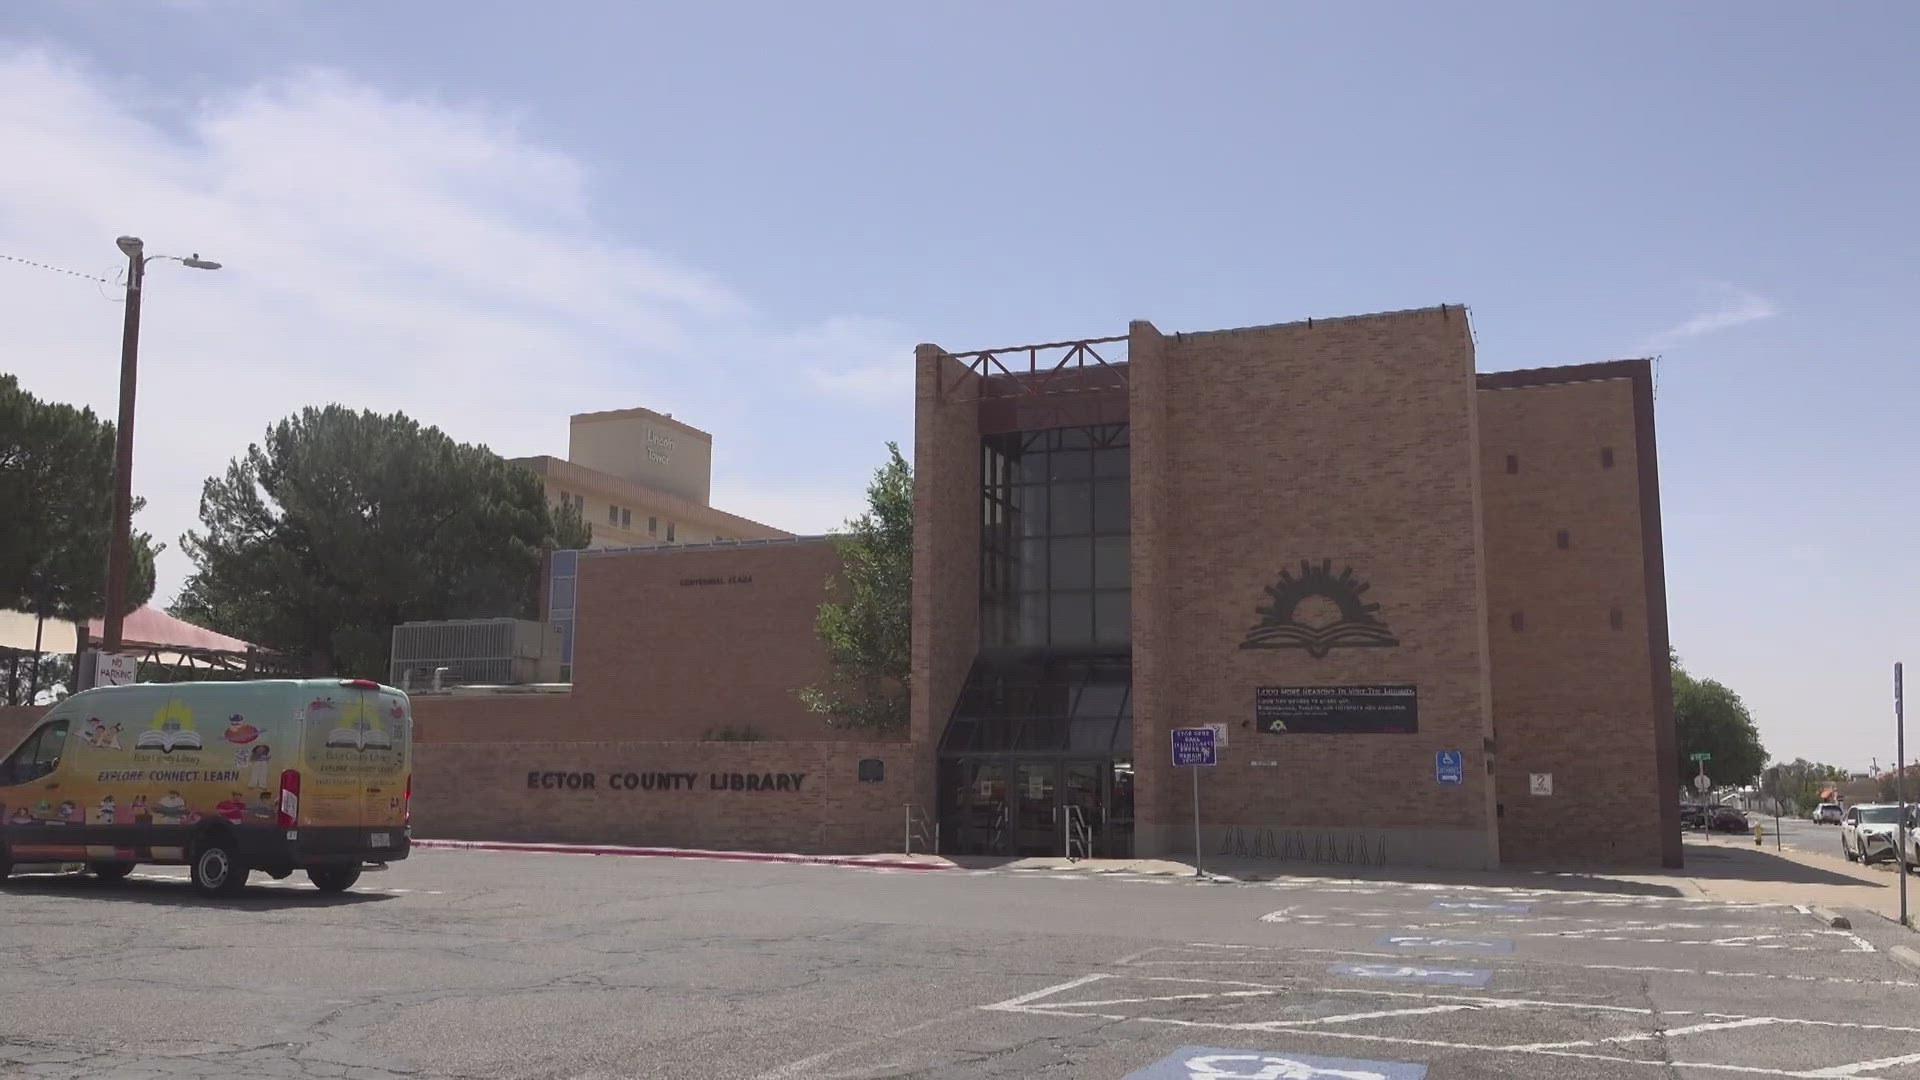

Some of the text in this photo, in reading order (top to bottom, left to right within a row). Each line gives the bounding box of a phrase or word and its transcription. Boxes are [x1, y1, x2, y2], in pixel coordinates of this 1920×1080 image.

[111, 658, 123, 668] NO
[100, 669, 133, 680] PARKING
[203, 771, 240, 782] LEARN
[528, 771, 807, 792] ECTOR COUNTY LIBRARY
